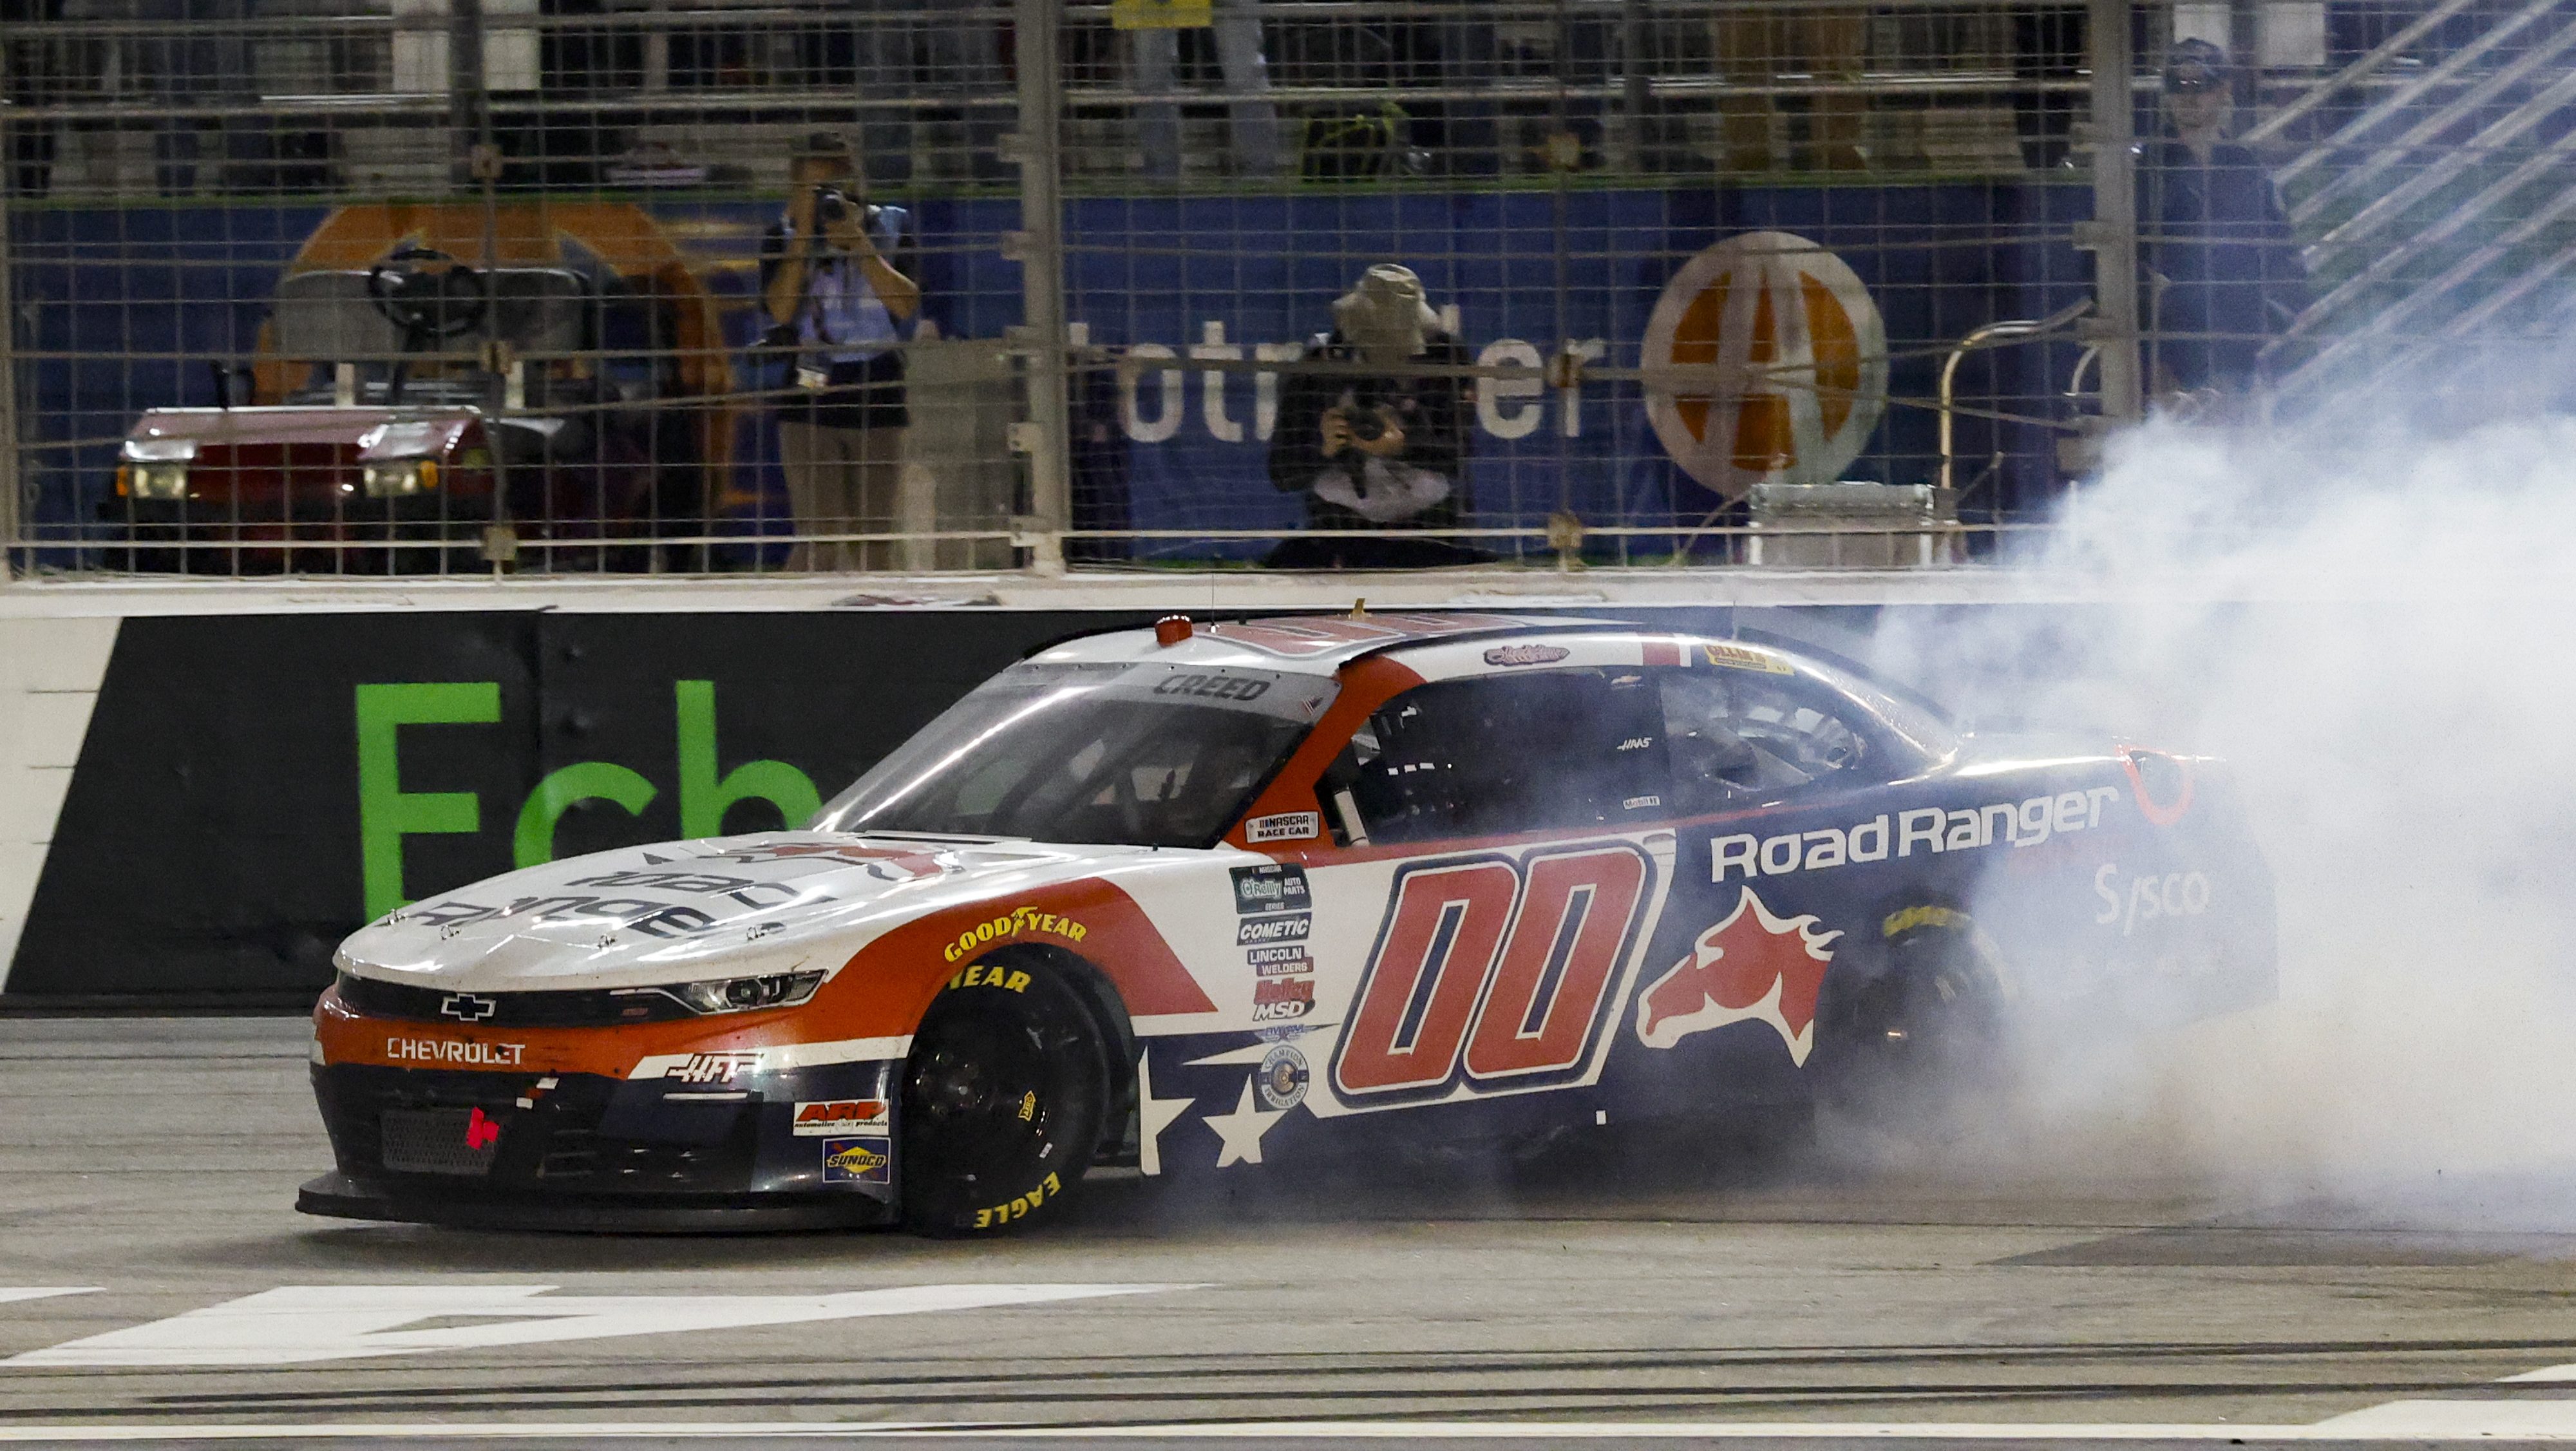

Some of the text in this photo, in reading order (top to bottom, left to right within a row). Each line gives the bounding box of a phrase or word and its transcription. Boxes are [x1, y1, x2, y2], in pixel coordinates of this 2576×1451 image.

[1153, 674, 1271, 701] CREED
[1617, 737, 1653, 751] HAAS
[1257, 826, 1309, 838] RACE CAR
[1269, 815, 1309, 828] NASCAR
[1710, 786, 2119, 884] Road Ranger
[1283, 877, 1302, 886] AUTO
[1283, 886, 1305, 896] PARTS
[2094, 863, 2211, 936] Sysco
[944, 907, 1087, 962] GOODYEAR
[1240, 918, 1309, 940] COMETIC
[1249, 947, 1302, 963] LINCOLN
[1262, 962, 1308, 975] WELDERS
[1329, 841, 1656, 1106] 00
[1253, 1000, 1311, 1021] MSD
[387, 1037, 526, 1065] CHEVROLET
[1264, 1048, 1304, 1069] CHAMPION
[1264, 1084, 1305, 1107] IRRIGATION
[795, 1101, 887, 1122] ARP
[828, 1154, 886, 1167] SUNOCO
[973, 1171, 1061, 1228] EAGLE
